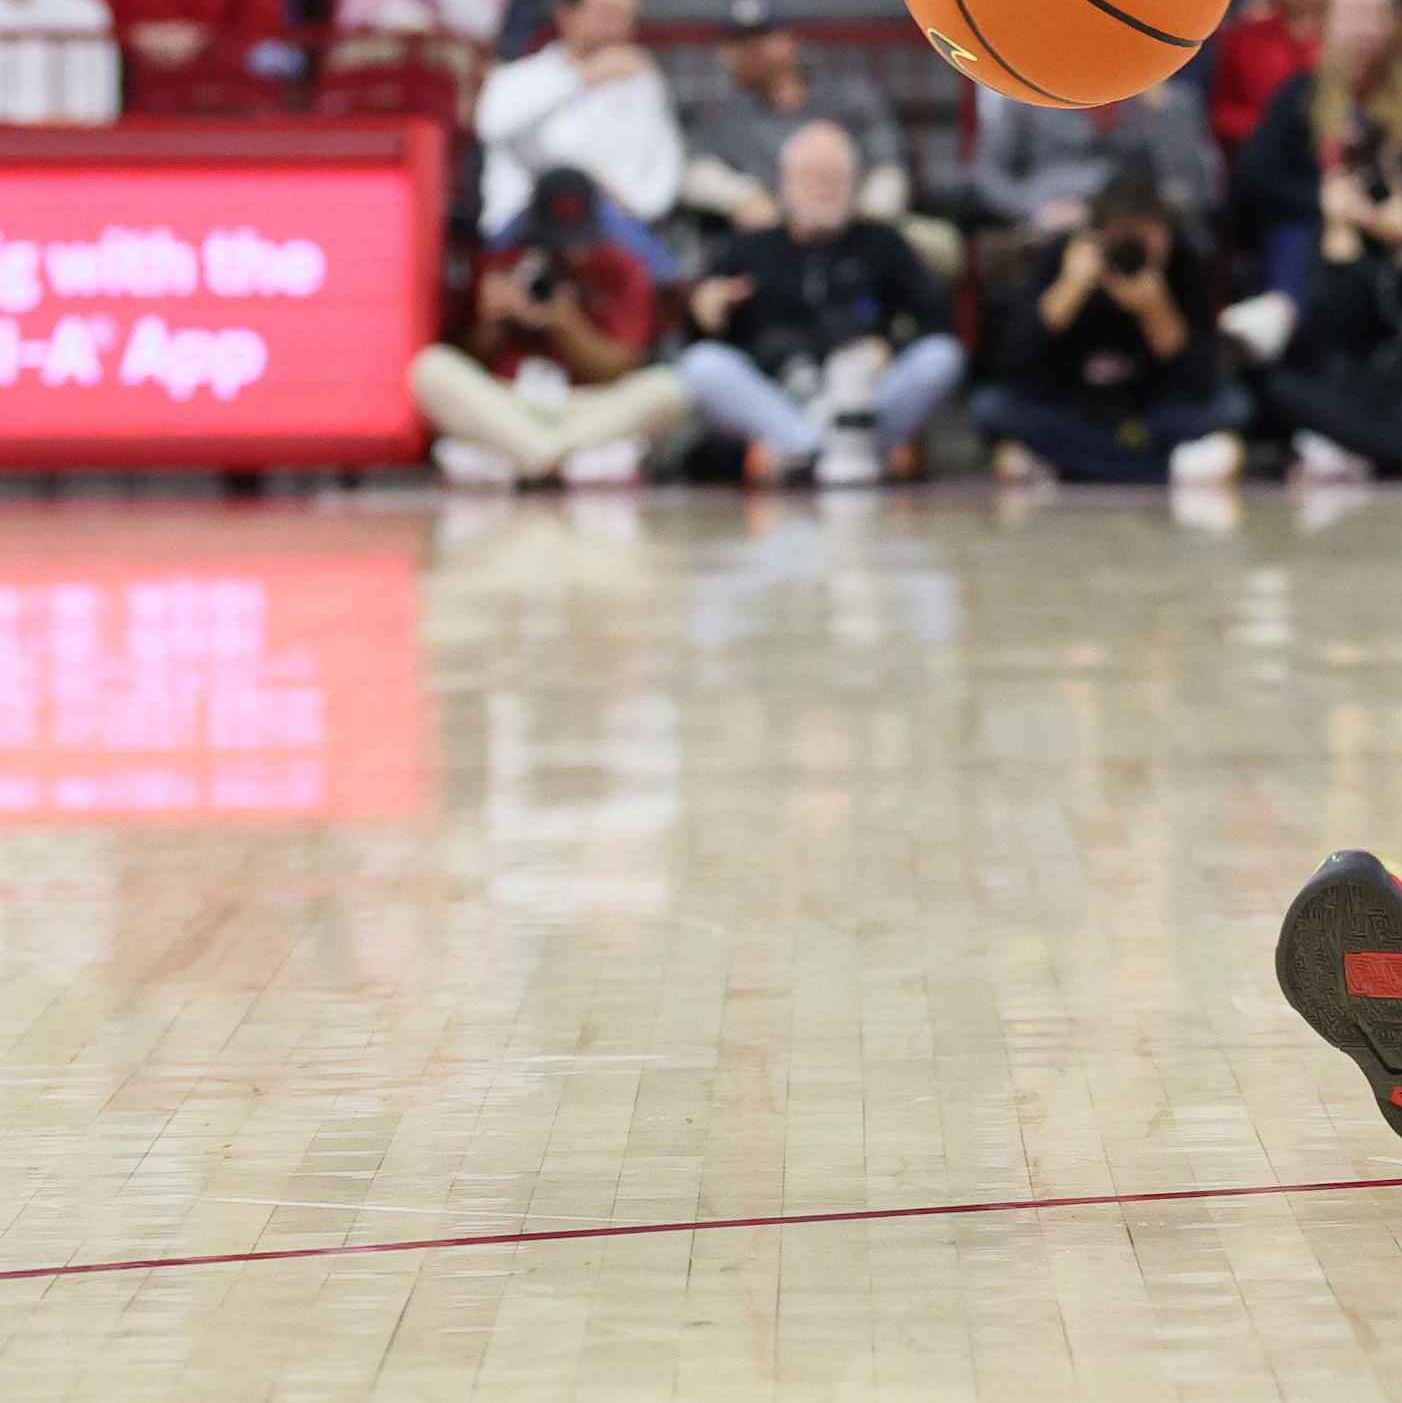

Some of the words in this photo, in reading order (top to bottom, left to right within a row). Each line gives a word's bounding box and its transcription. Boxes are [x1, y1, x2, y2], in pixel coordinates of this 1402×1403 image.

[46, 226, 198, 297] with
[204, 226, 327, 297] the
[119, 314, 267, 401] App
